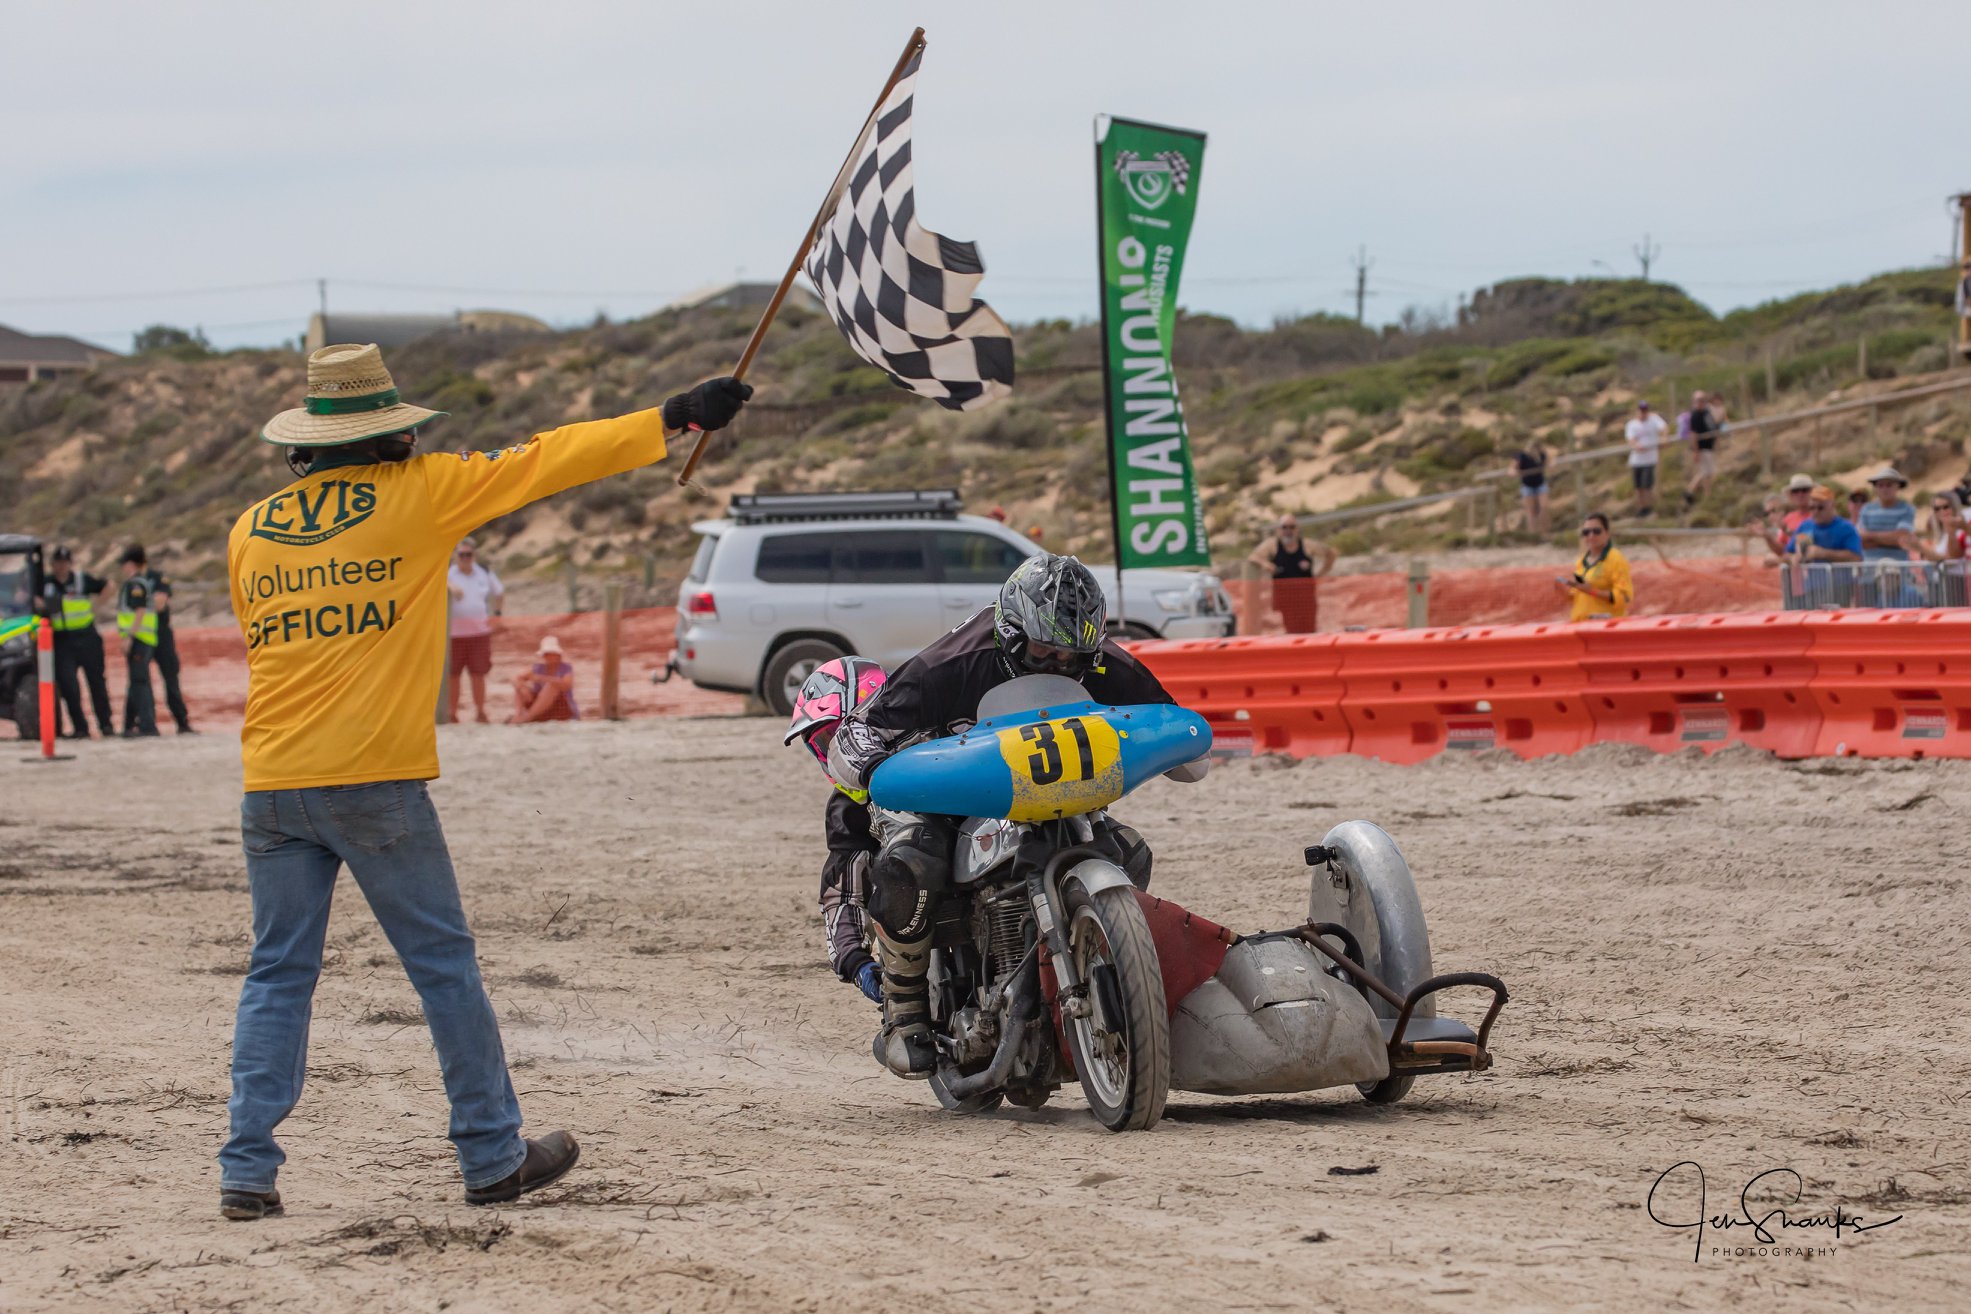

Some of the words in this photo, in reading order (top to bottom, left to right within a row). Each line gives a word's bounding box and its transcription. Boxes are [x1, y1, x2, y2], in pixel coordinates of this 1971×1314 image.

[250, 480, 377, 536] LEVIS
[274, 533, 324, 545] MOTORCYCLE
[325, 525, 347, 539] CLUB
[243, 556, 404, 603] Volunteer
[248, 600, 402, 650] OFFICIAL
[1020, 718, 1095, 786] 31
